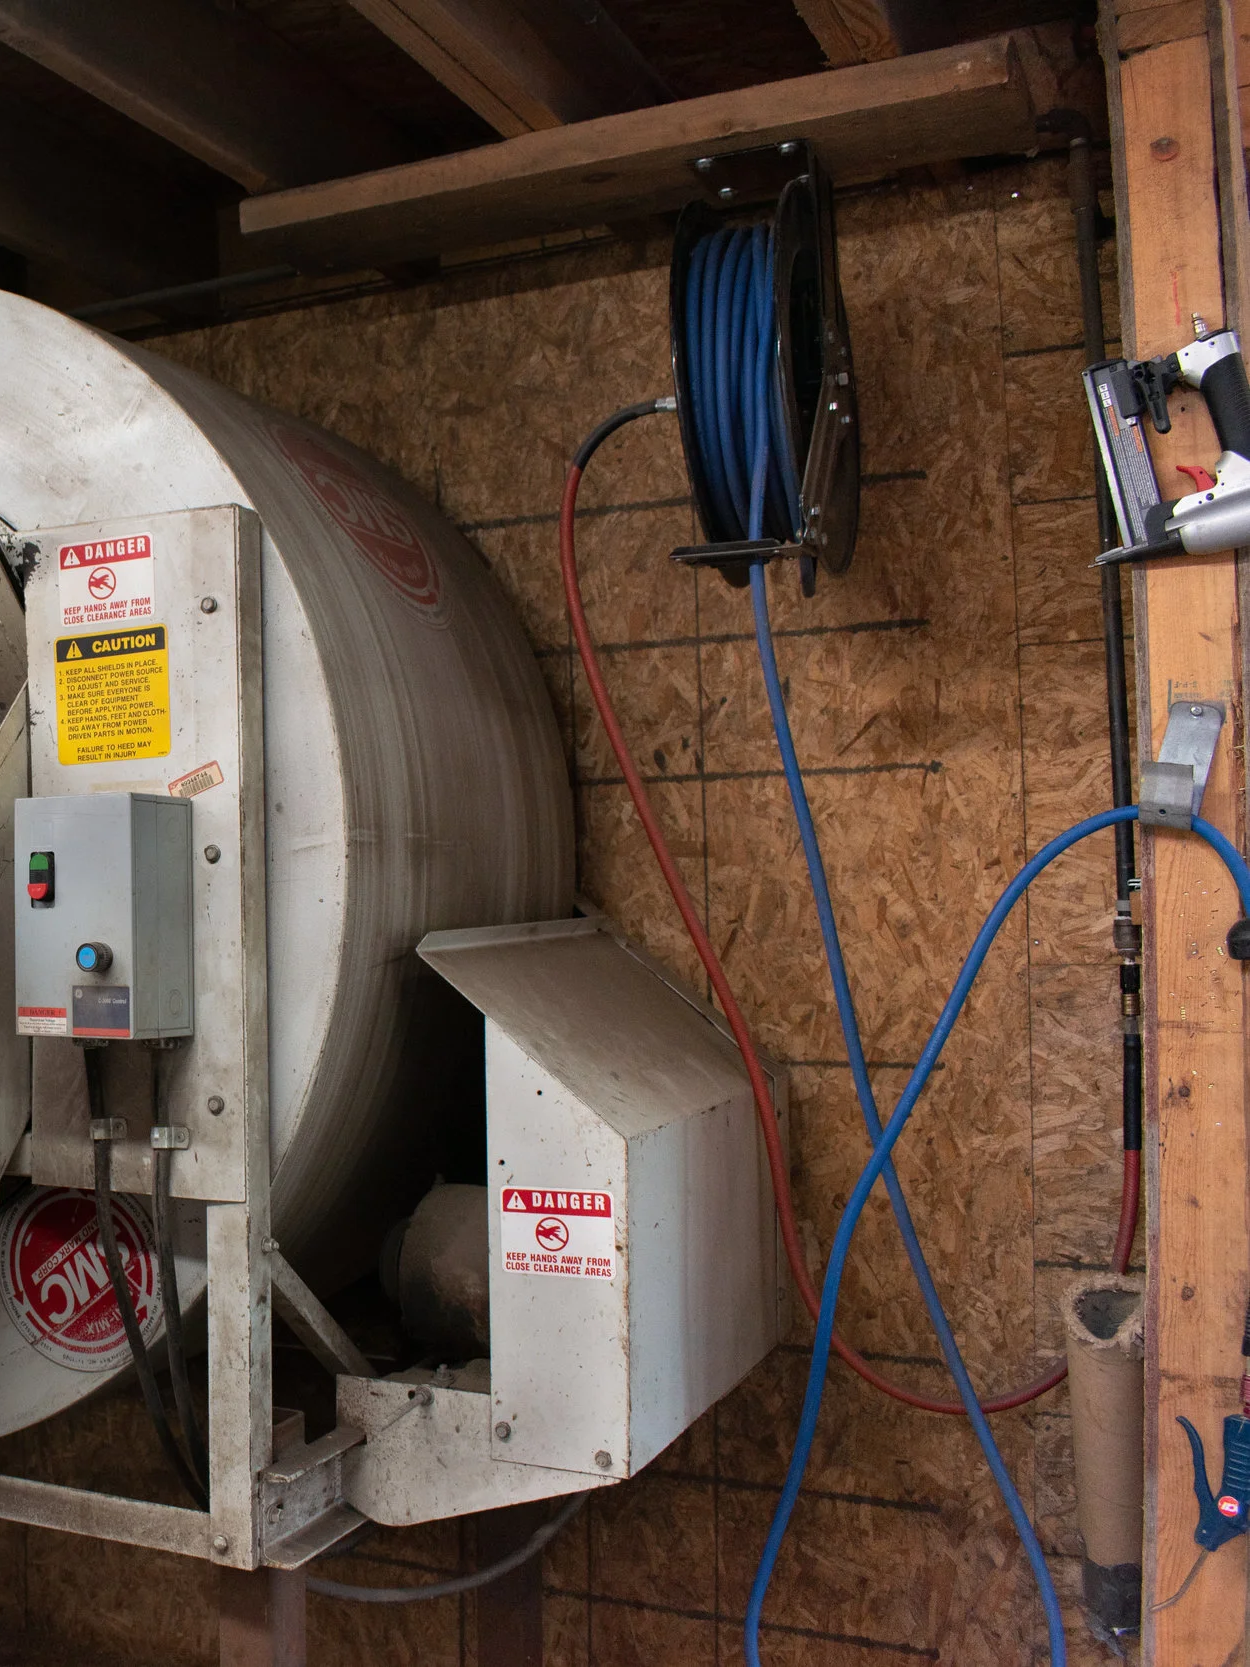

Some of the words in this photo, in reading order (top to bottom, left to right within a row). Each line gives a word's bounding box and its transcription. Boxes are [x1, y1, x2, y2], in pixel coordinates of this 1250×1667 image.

[84, 537, 146, 560] DANGER
[64, 606, 81, 616] KEEP
[84, 603, 107, 613] HANDS
[110, 600, 128, 610] AWAY
[131, 597, 151, 607] FROM
[64, 615, 84, 625] CLOSE
[87, 610, 126, 622] CLEARANCE
[130, 607, 151, 617] AREAS
[92, 633, 156, 653] CAUTION
[66, 668, 82, 676] KEEP
[97, 663, 125, 673] SHIELDS
[67, 673, 107, 684] DISCONNECT
[110, 669, 134, 679] POWER
[136, 666, 163, 676] SOURCE
[77, 681, 102, 691] ADJUST
[105, 680, 119, 688] AND
[121, 676, 151, 686] SERVICE.
[67, 692, 85, 700] MAKE
[88, 689, 105, 697] SURE
[107, 685, 142, 695] EVERYONE
[67, 700, 88, 708] CLEAR
[90, 698, 99, 706] OF
[101, 695, 138, 705] EQUIPMENT
[67, 708, 92, 716] BEFORE
[95, 703, 127, 713] APPLYING
[130, 701, 155, 710] POWER.
[67, 716, 83, 724] KEEP
[85, 714, 109, 723] HANDS,
[110, 712, 126, 720] FEET
[128, 710, 141, 718] AND
[143, 708, 167, 717] CLOTH-
[81, 723, 100, 731] AWAY
[102, 721, 121, 729] FROM
[123, 719, 148, 727] POWER
[68, 732, 91, 741] DRIVEN
[93, 729, 115, 738] PARTS
[126, 726, 154, 735] MOTION.
[77, 744, 104, 753] FAILURE
[107, 743, 115, 751] TO
[117, 742, 135, 750] HEED
[137, 740, 152, 748] MAY
[78, 753, 102, 761] RESULT
[113, 750, 137, 758] INJURY
[531, 1192, 605, 1211] DANGER
[60, 1234, 83, 1260] MARK
[506, 1251, 527, 1261] KEEP
[530, 1253, 558, 1263] HANDS
[561, 1255, 583, 1265] AWAY
[587, 1257, 610, 1267] FROM
[34, 1257, 60, 1279] CORP.
[41, 1225, 130, 1325] SMC
[505, 1261, 530, 1271] CLOSE
[533, 1263, 581, 1275] CLEARANCE
[584, 1268, 612, 1278] AREAS
